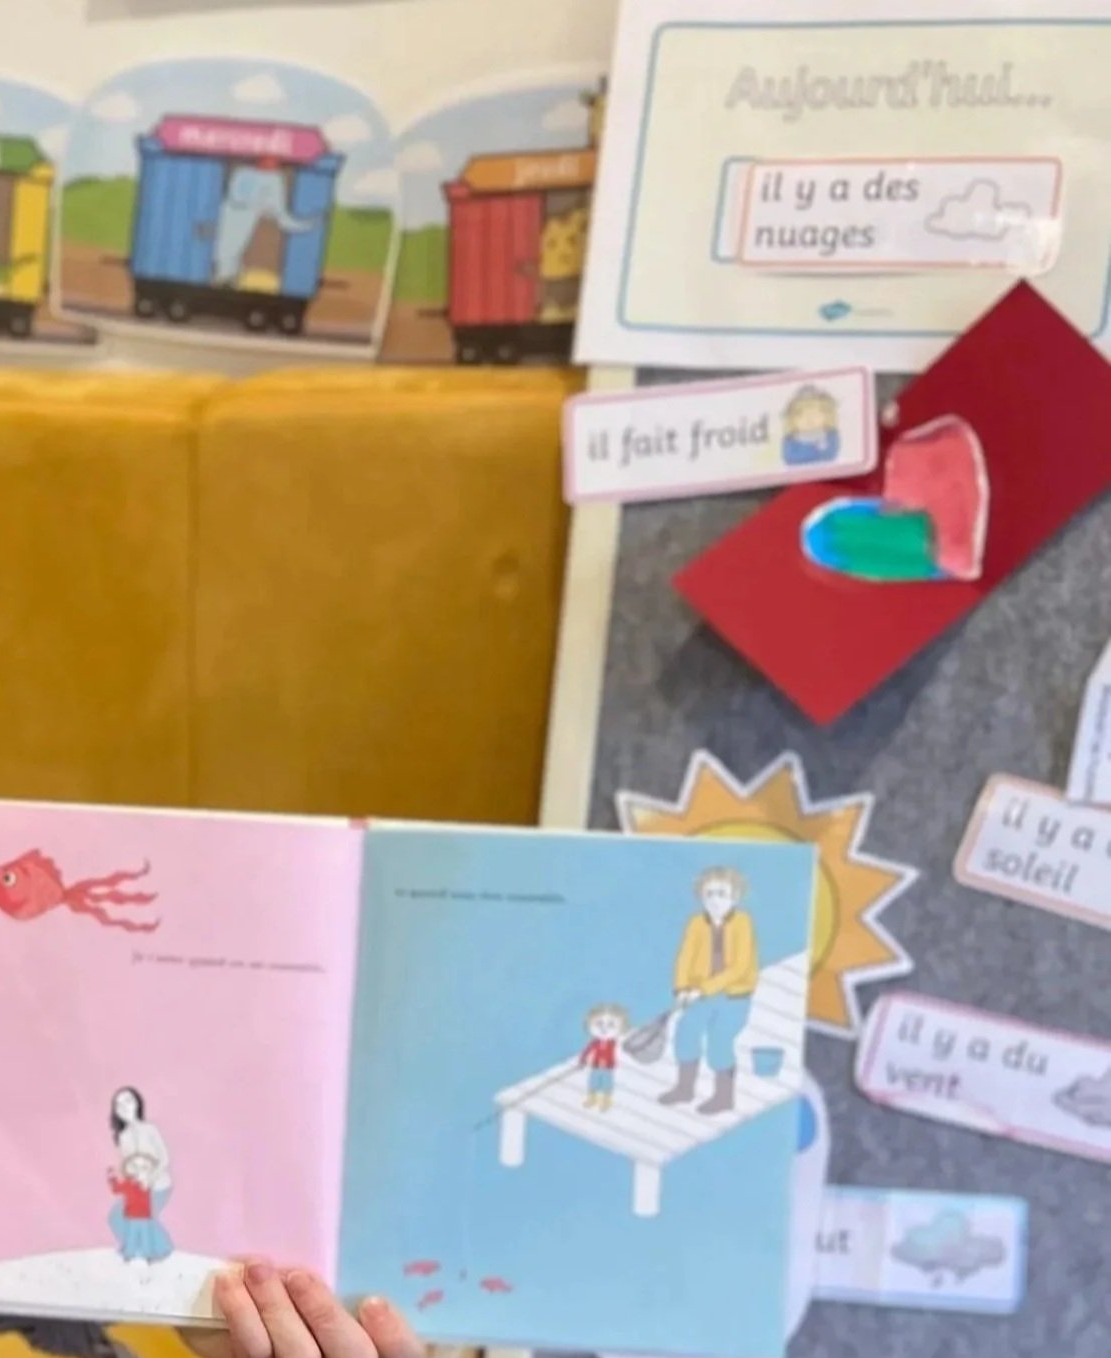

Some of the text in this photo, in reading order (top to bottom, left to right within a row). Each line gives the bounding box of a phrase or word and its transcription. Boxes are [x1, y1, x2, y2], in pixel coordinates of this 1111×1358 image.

[761, 170, 920, 211] il y a des
[755, 224, 875, 257] nuages
[588, 412, 769, 468] il fait froid
[1000, 797, 1027, 830] il
[1036, 815, 1061, 847] y
[1070, 826, 1095, 850] a
[982, 848, 1079, 893] soleil
[897, 1012, 1047, 1076] il y a du
[886, 1062, 961, 1101] vent
